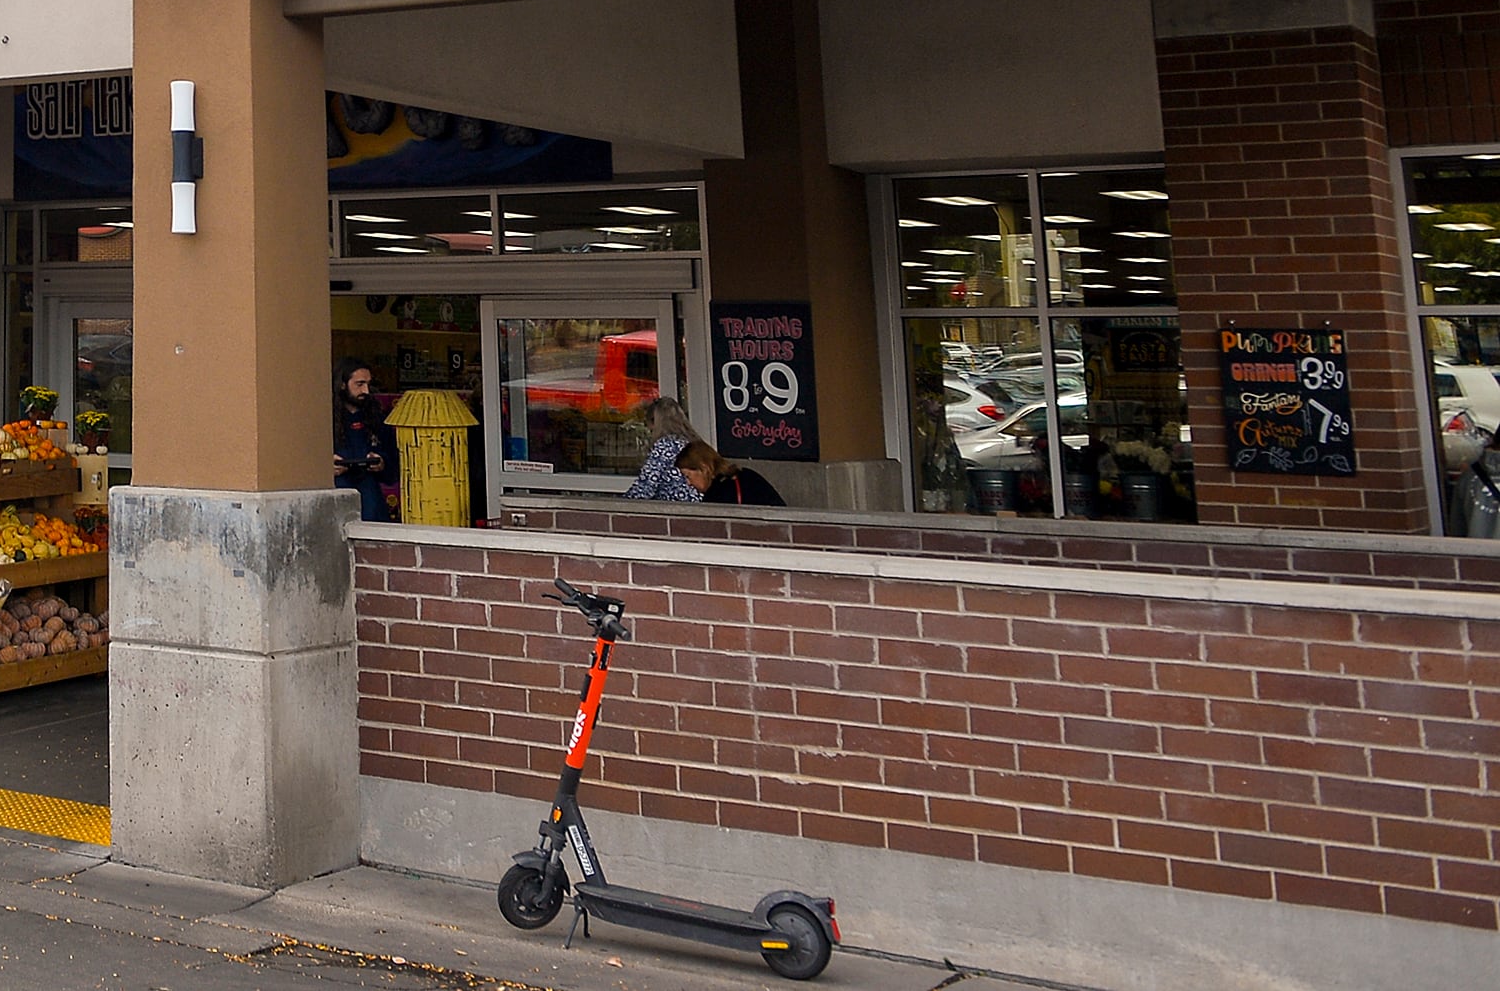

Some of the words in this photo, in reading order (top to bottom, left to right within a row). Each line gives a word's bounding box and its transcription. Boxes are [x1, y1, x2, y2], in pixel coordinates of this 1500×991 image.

[719, 316, 802, 339] TRADING
[404, 353, 412, 369] 8
[452, 353, 461, 369] 9
[729, 340, 794, 360] HOURS
[1302, 357, 1344, 390] 3.99
[721, 361, 749, 412] 8
[753, 383, 763, 394] to
[761, 362, 798, 414] 9
[731, 418, 803, 448] Everyday
[1308, 398, 1350, 443] 7.99
